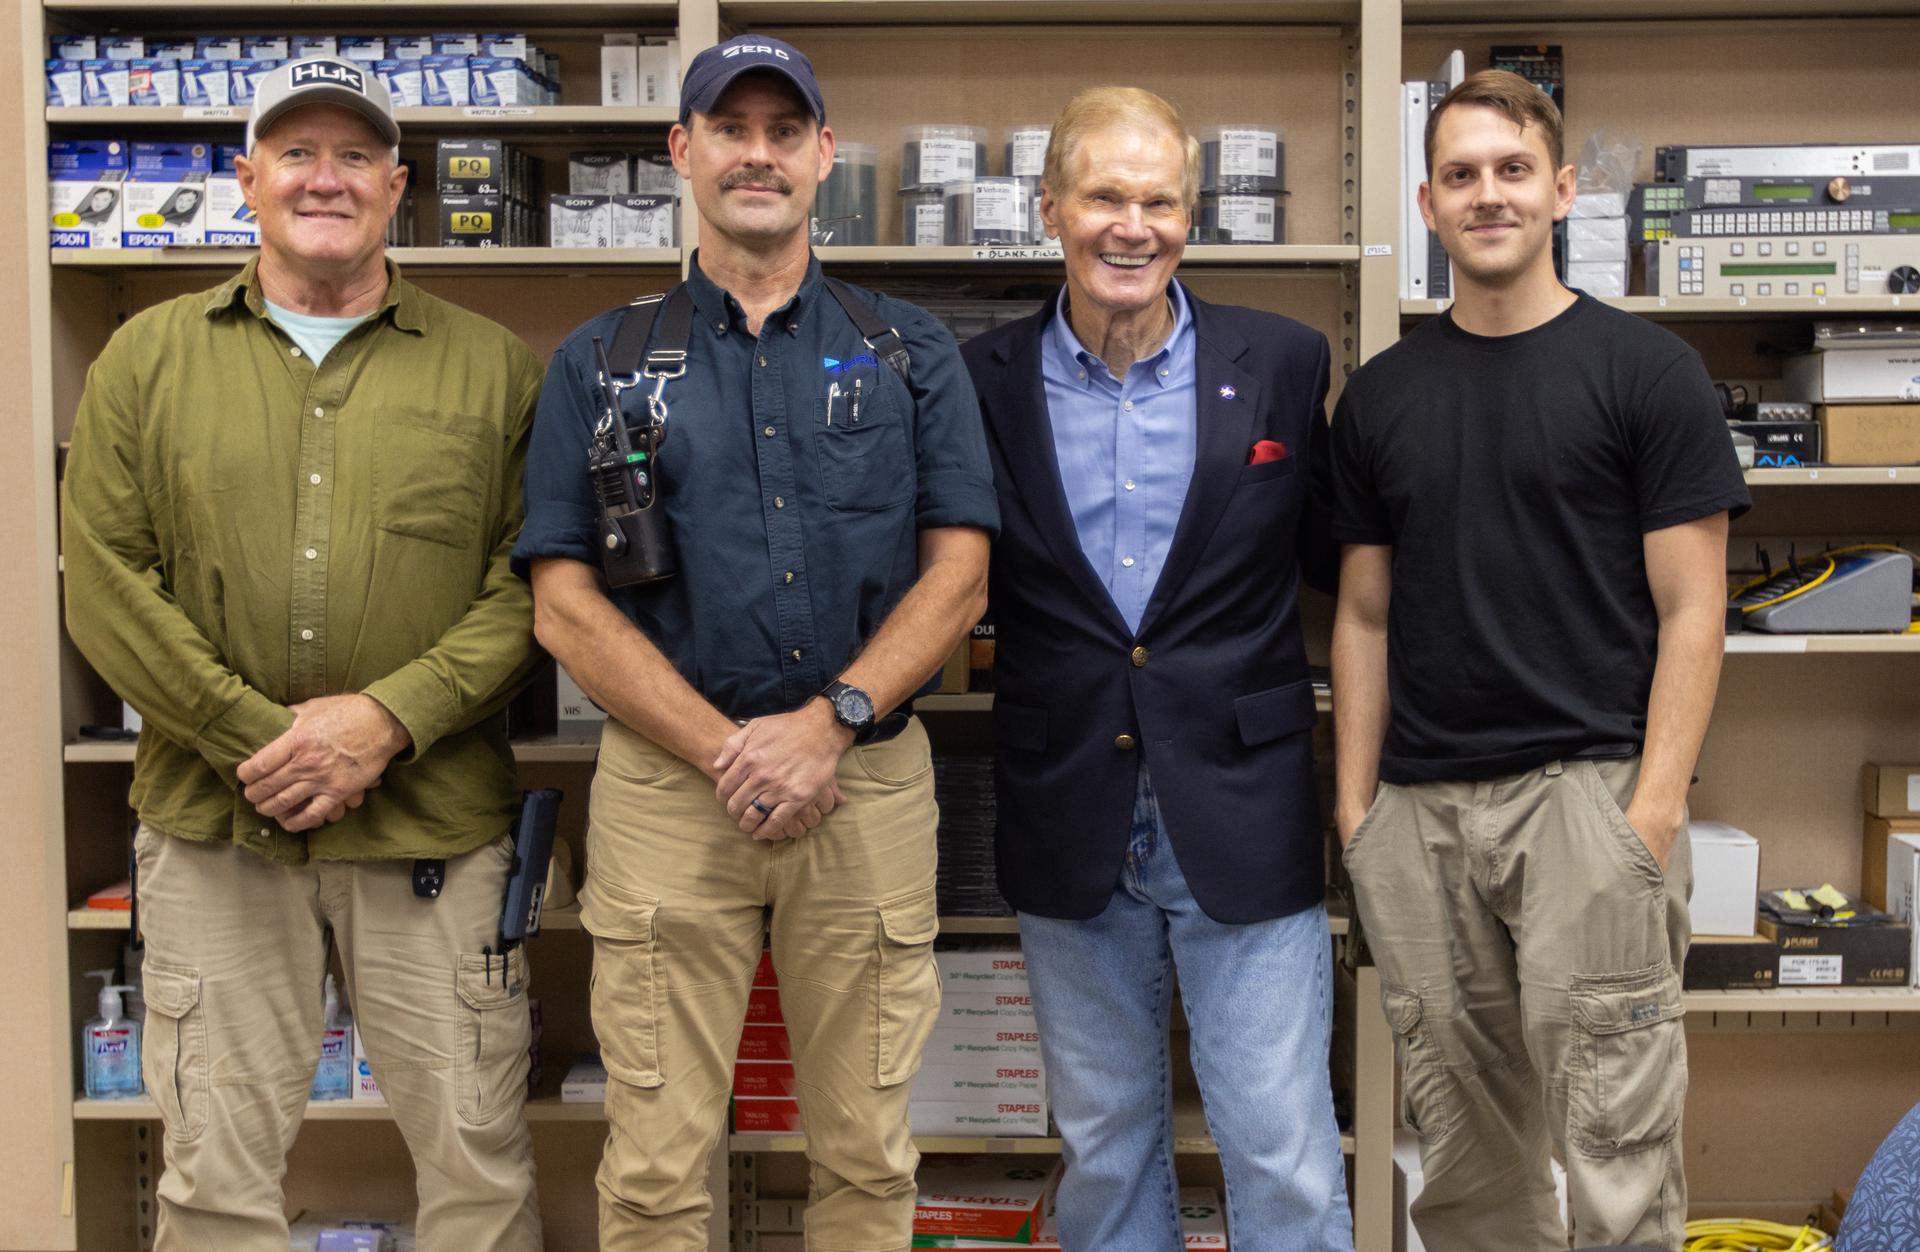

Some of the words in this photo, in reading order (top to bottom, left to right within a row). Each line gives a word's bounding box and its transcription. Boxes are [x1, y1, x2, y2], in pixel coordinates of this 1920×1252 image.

[52, 233, 86, 246] PSON
[128, 234, 170, 246] EPSON
[210, 233, 251, 245] EPSON
[989, 250, 1027, 259] BLANK
[1758, 454, 1802, 468] AJA
[564, 706, 581, 715] VHS
[996, 996, 1032, 1006] STAPLE
[996, 1032, 1039, 1042] STAPLES
[996, 1069, 1039, 1079] STAPLES
[998, 1104, 1041, 1113] STAPLES
